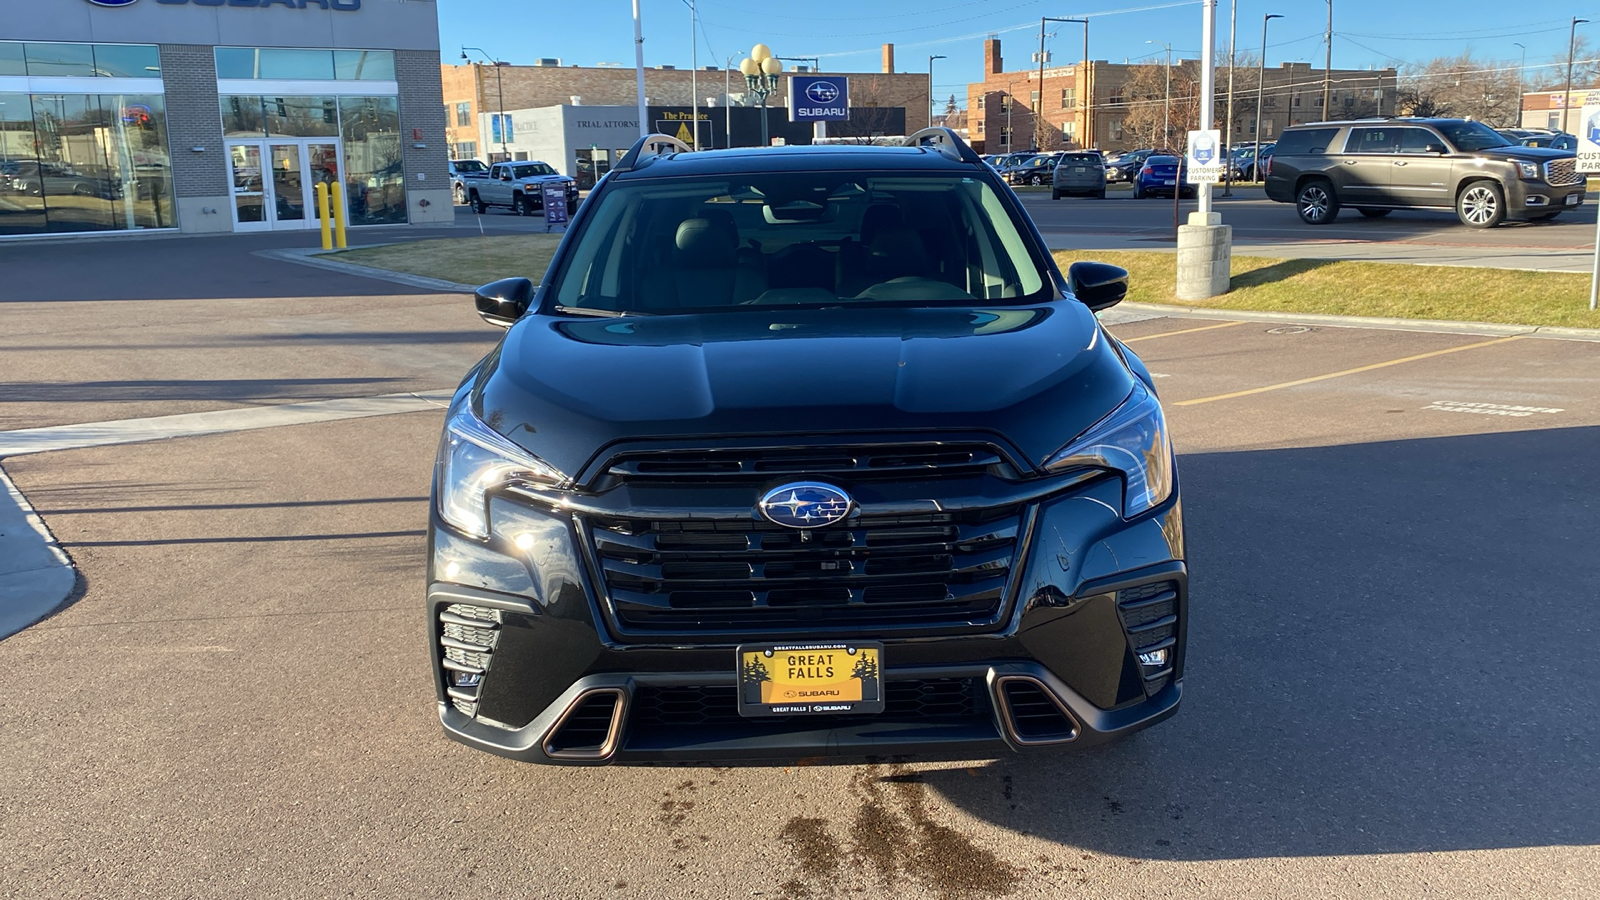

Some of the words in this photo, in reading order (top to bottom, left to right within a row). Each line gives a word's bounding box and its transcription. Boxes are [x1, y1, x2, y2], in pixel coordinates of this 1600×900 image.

[663, 111, 678, 120] The
[679, 111, 709, 120] Pracice
[798, 107, 845, 117] SUBARU
[577, 120, 602, 129] TRIAL
[788, 655, 834, 666] GREAT
[788, 666, 834, 678] FALLS
